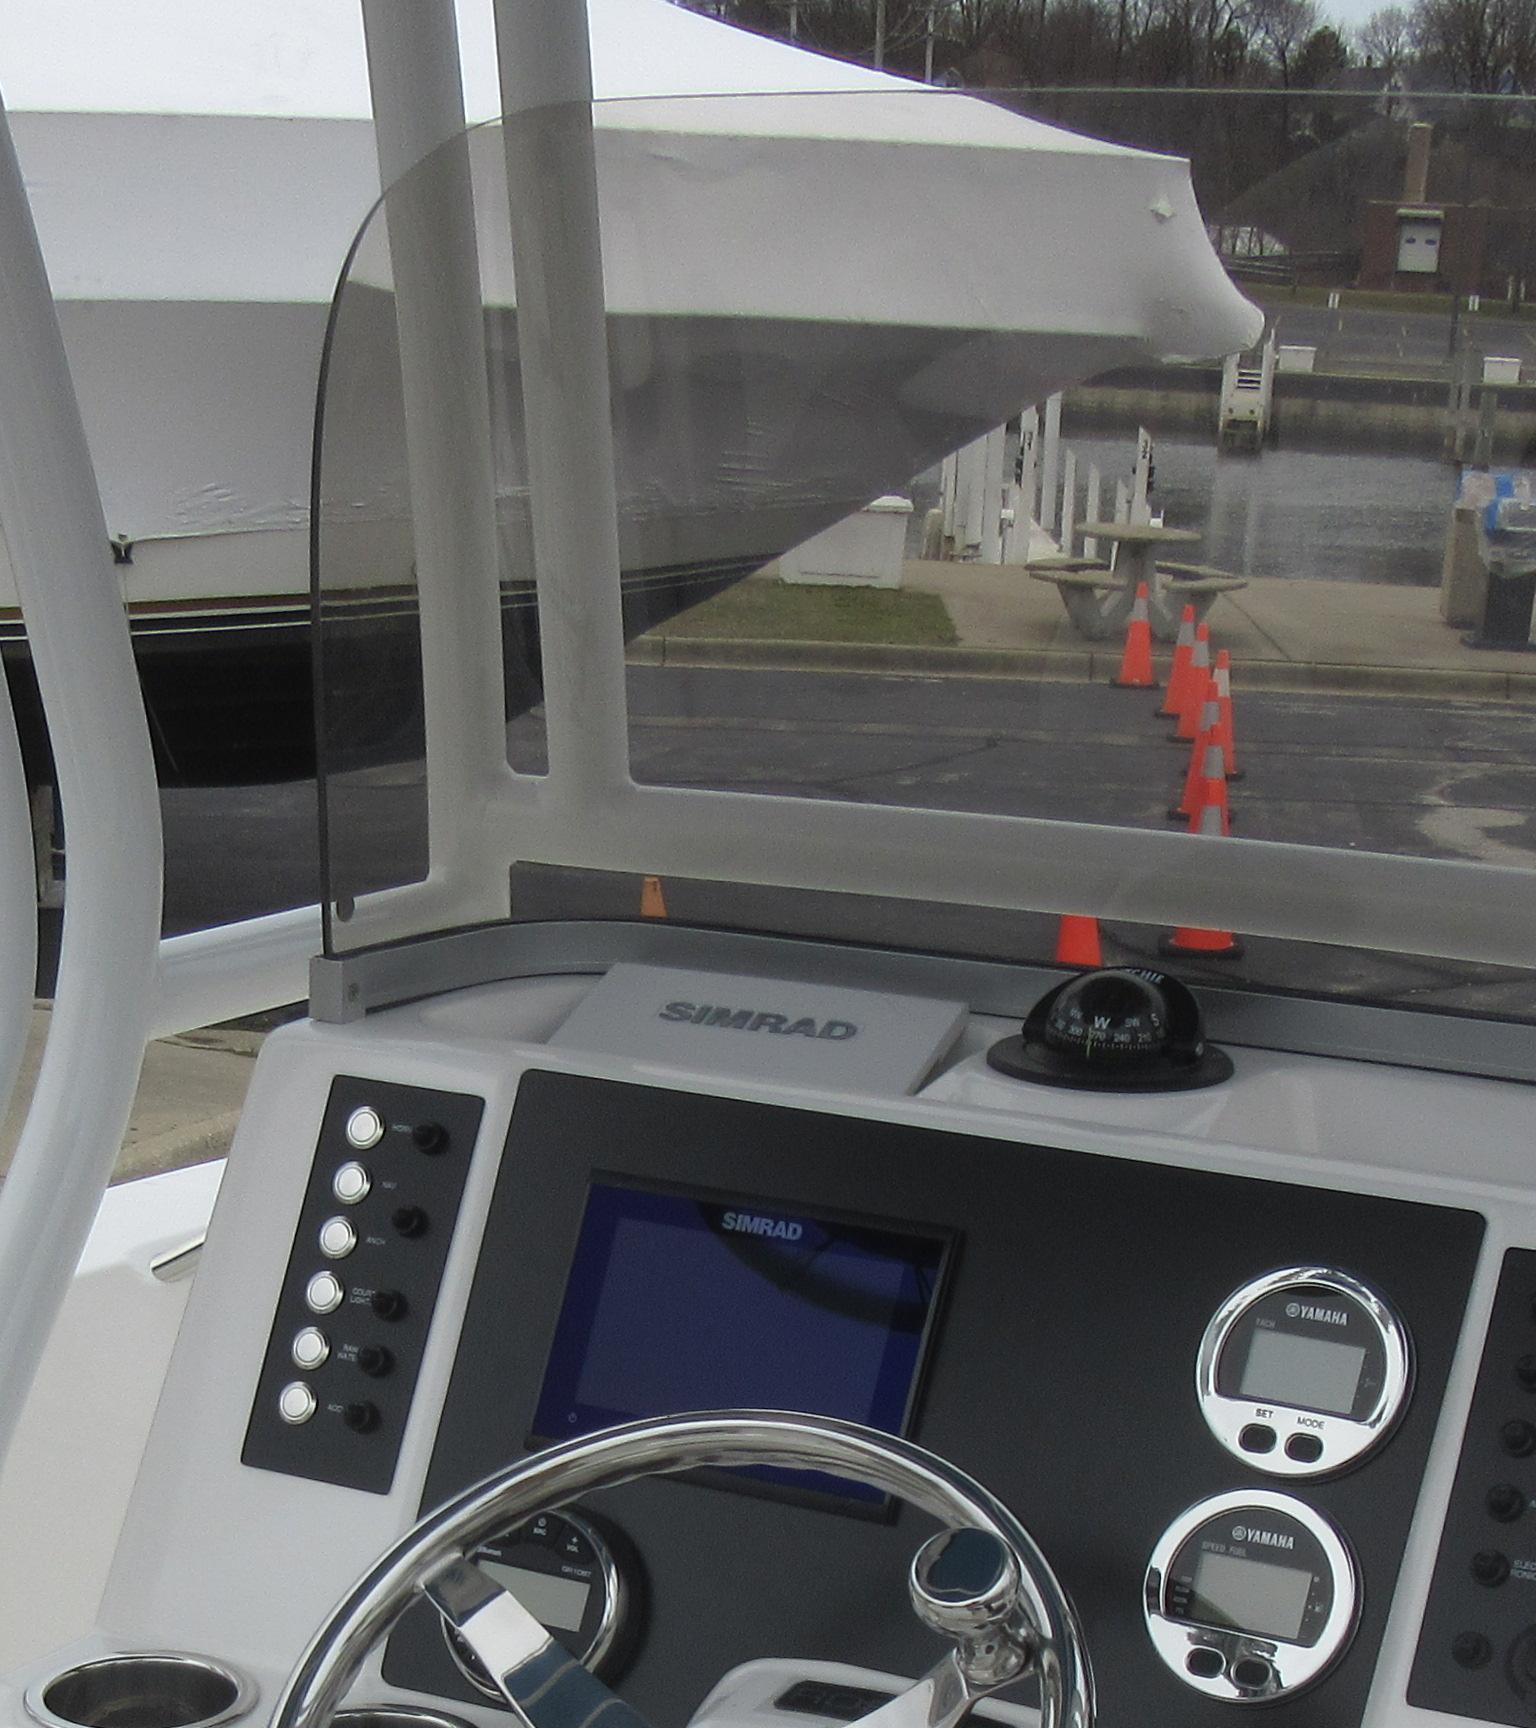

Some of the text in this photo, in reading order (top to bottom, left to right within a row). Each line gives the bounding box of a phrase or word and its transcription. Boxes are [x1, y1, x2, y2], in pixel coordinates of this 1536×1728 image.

[659, 1002, 858, 1040] SIMRAD
[1094, 1016, 1111, 1029] W
[1151, 1013, 1159, 1027] S
[722, 1212, 802, 1240] SIMRAD
[1300, 1305, 1349, 1326] YAMAHA
[1255, 1409, 1274, 1418] SET
[1296, 1416, 1325, 1430] MODE
[1202, 1541, 1226, 1552] SPEED
[1246, 1528, 1295, 1549] YAMAHA
